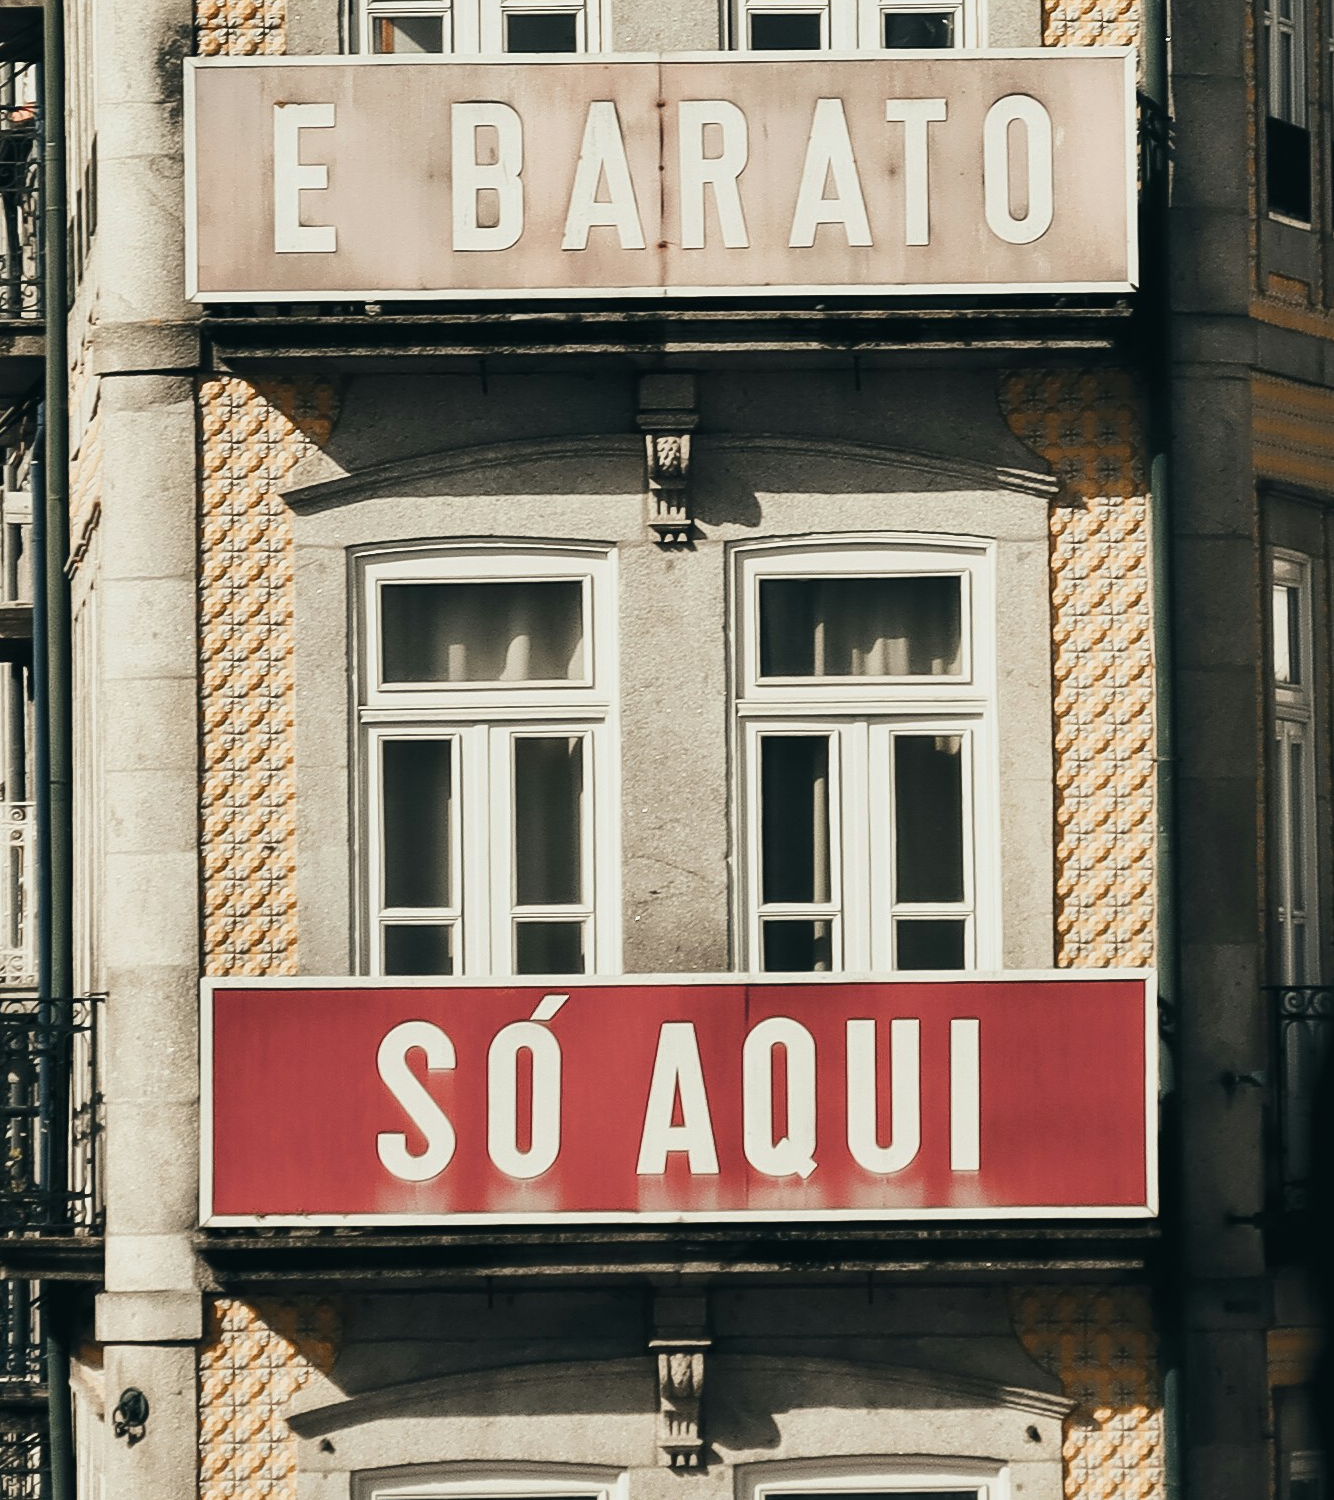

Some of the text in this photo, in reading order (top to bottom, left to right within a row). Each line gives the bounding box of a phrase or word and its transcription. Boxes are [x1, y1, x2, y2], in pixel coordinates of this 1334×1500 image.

[273, 94, 1054, 254] E BARATO
[376, 994, 980, 1182] SÓ AQUI
